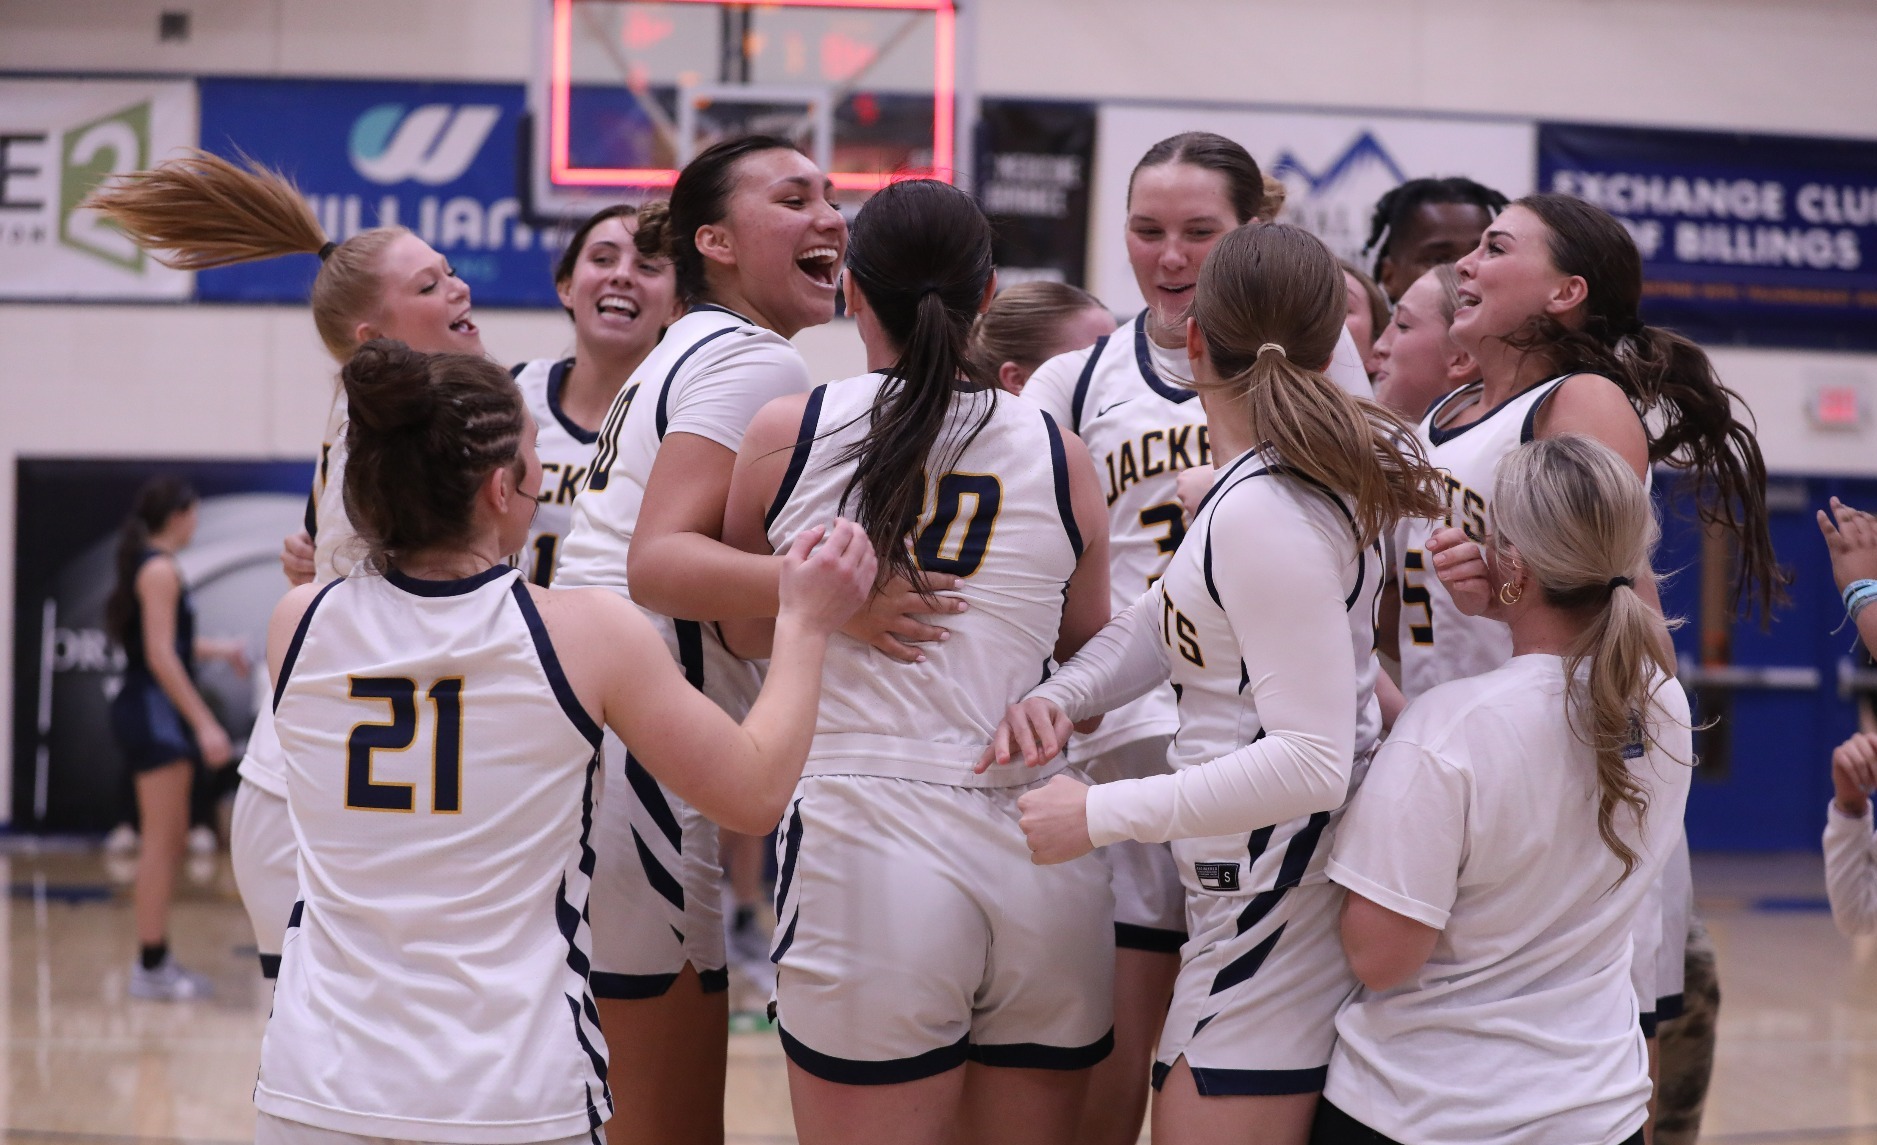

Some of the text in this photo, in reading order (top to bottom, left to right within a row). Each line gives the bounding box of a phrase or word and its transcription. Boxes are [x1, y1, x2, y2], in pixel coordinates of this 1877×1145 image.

[1553, 169, 1786, 220] EXCHANGE
[1674, 220, 1862, 270] BILLINGS
[344, 673, 465, 814] 21
[1224, 871, 1231, 883] S
